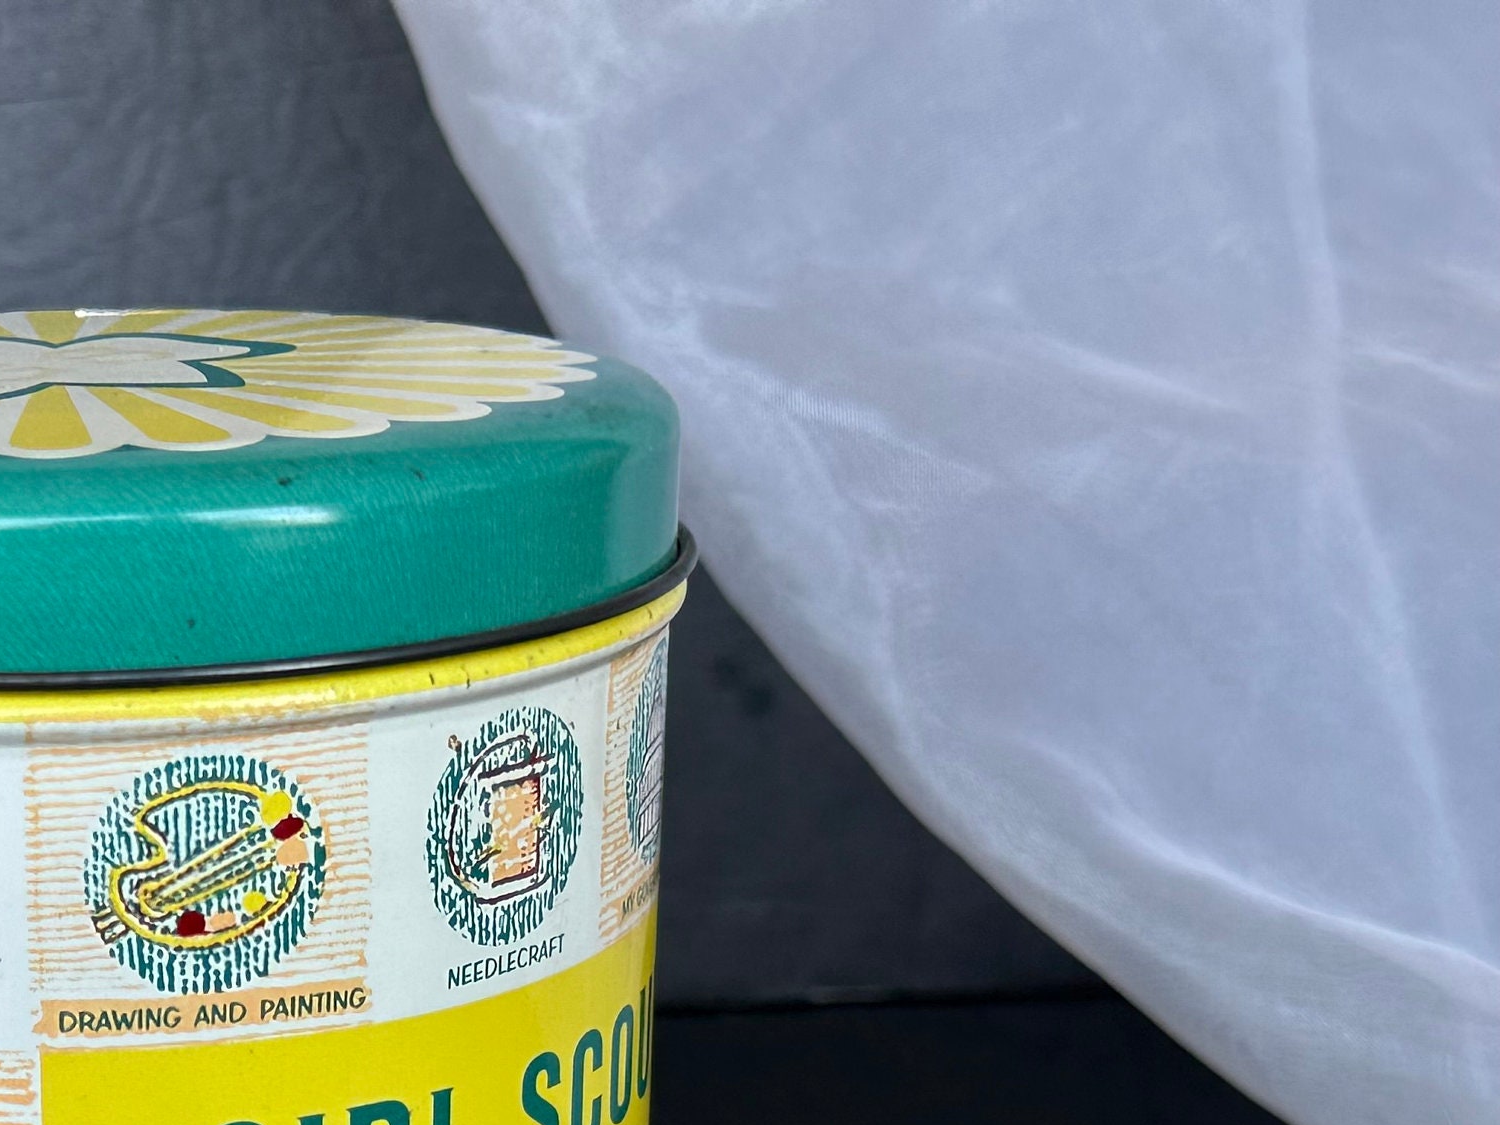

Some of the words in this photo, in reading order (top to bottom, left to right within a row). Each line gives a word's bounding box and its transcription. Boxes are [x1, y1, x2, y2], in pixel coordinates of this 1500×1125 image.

[448, 933, 565, 990] NEEDLECRAFT
[58, 1006, 182, 1034] DRAWING
[194, 1001, 247, 1028] AND
[260, 987, 367, 1020] PAINTING
